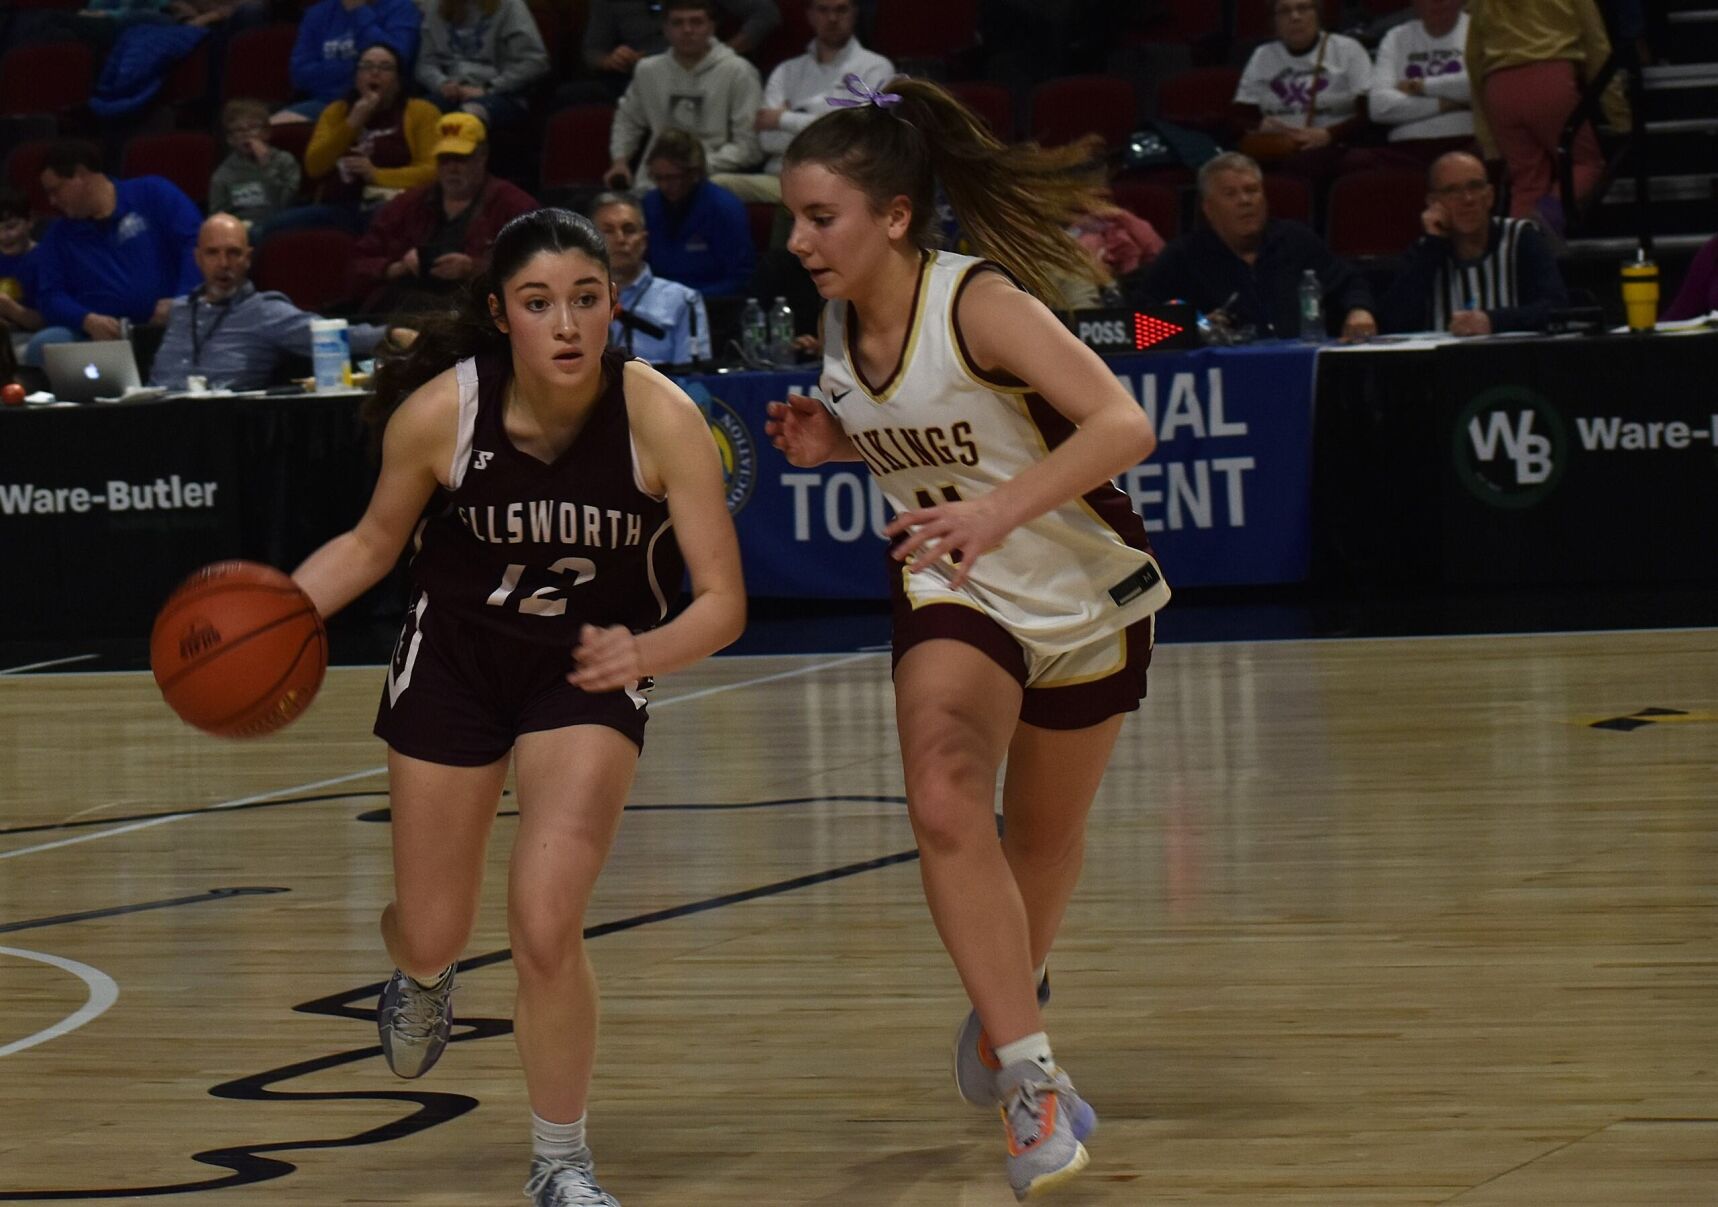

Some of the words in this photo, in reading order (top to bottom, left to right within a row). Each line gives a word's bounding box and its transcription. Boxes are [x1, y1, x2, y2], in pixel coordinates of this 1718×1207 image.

[1078, 319, 1131, 345] POSS.
[848, 421, 979, 477] IKINGS
[1468, 409, 1554, 485] WB
[1575, 413, 1718, 451] Ware-
[0, 474, 218, 515] Ware-Butler
[486, 556, 597, 617] 12
